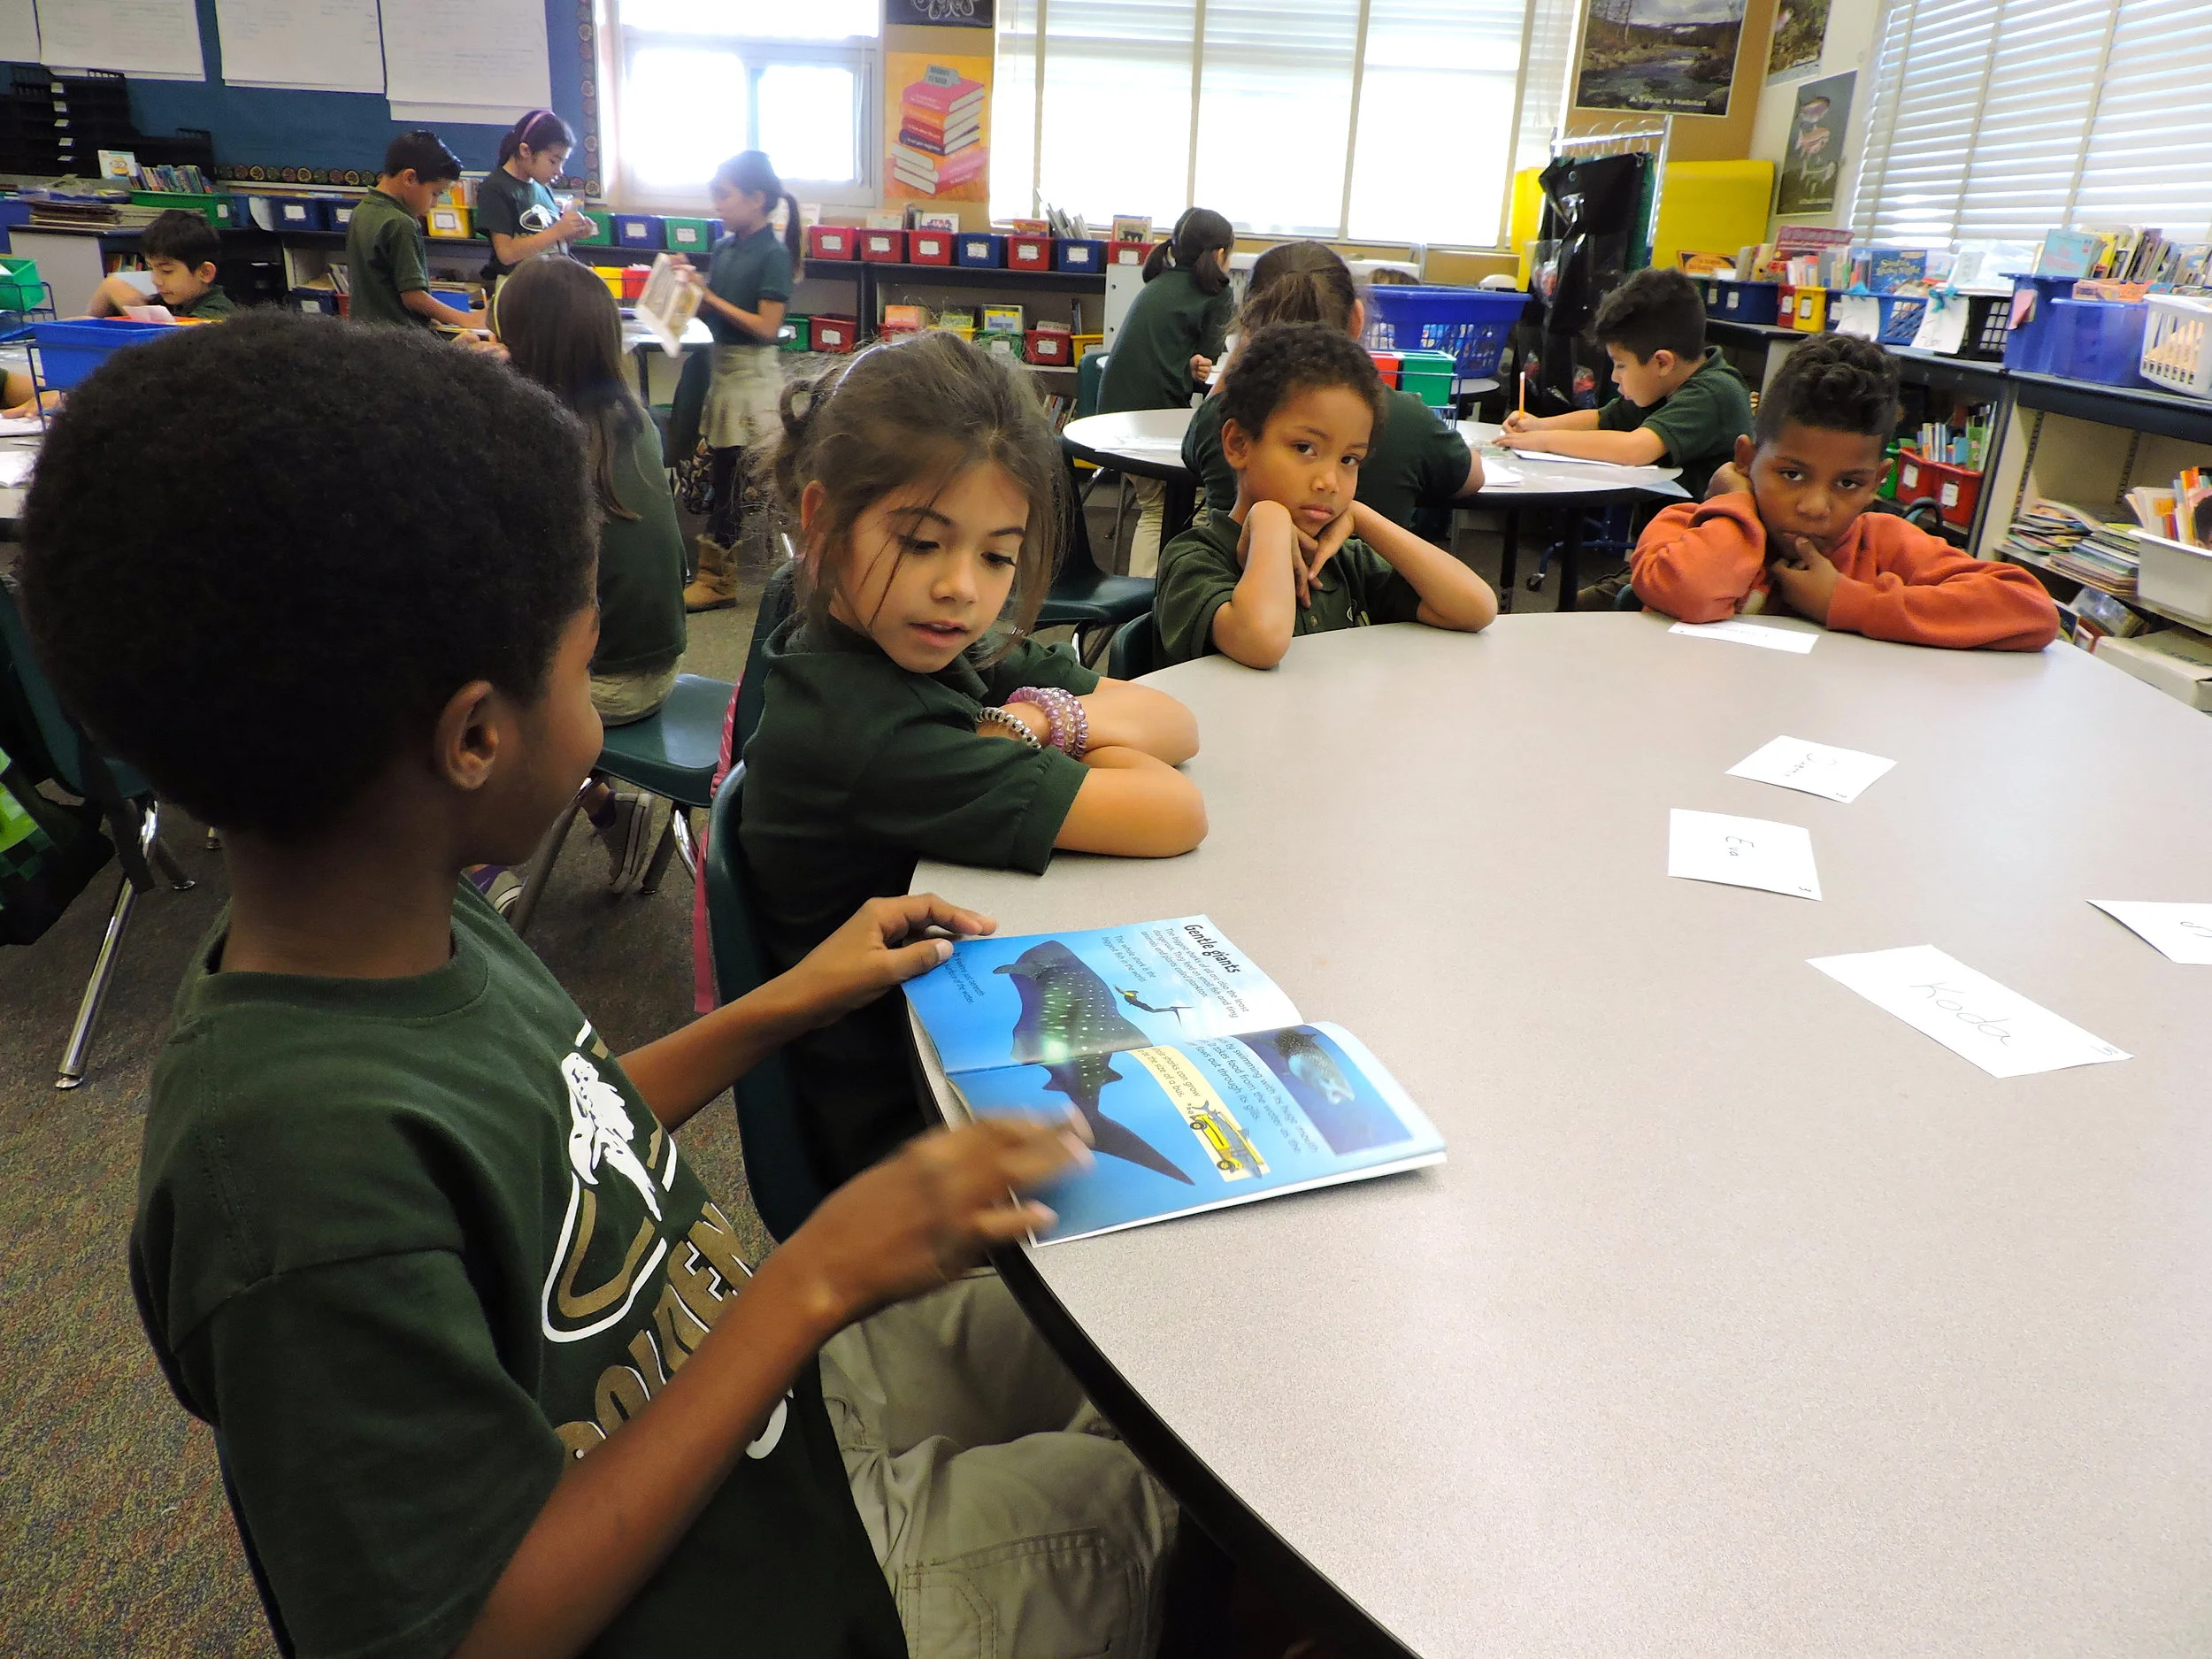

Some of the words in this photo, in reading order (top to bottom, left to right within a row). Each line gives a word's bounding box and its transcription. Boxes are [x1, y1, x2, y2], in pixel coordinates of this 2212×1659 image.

[1725, 835, 1755, 856] Eva
[1102, 936, 1118, 952] biggest
[1114, 951, 1125, 960] fish
[1121, 943, 1134, 956] whale
[1132, 956, 1146, 966] shark
[1141, 931, 1158, 948] animals
[1155, 947, 1168, 956] and
[1184, 925, 1217, 949] Gentle
[1202, 950, 1240, 973] giants
[1161, 954, 1178, 967] plants
[1171, 936, 1189, 951] biggest
[1186, 950, 1202, 964] sharks
[1210, 972, 1219, 981] are
[1217, 980, 1229, 990] also
[1226, 989, 1237, 998] the
[1235, 998, 1249, 1012] least
[1174, 967, 1191, 979] called
[1173, 951, 1185, 962] They
[1184, 961, 1196, 971] feed
[1198, 974, 1214, 987] small
[1210, 987, 1220, 995] fish
[1217, 995, 1232, 1005] and
[1226, 1005, 1238, 1018] tiny
[1909, 982, 2011, 1047] Koda
[1155, 1064, 1166, 1073] size
[1163, 1056, 1179, 1071] sharks
[1177, 1071, 1187, 1080] can
[1183, 1081, 1201, 1097] grow
[1195, 1046, 1211, 1059] flows
[1208, 1057, 1222, 1068] out
[1217, 1068, 1242, 1094] through
[1239, 1093, 1248, 1104] its
[1212, 1045, 1230, 1061] takes
[1227, 1059, 1245, 1074] food
[1240, 1073, 1256, 1091] from
[1254, 1091, 1266, 1104] the
[1263, 1105, 1283, 1127] water
[1279, 1127, 1289, 1139] as
[1287, 1139, 1302, 1154] the
[1233, 1049, 1263, 1079] swimming
[1260, 1079, 1277, 1094] with
[1274, 1094, 1283, 1105] its
[1280, 1104, 1298, 1125] huge
